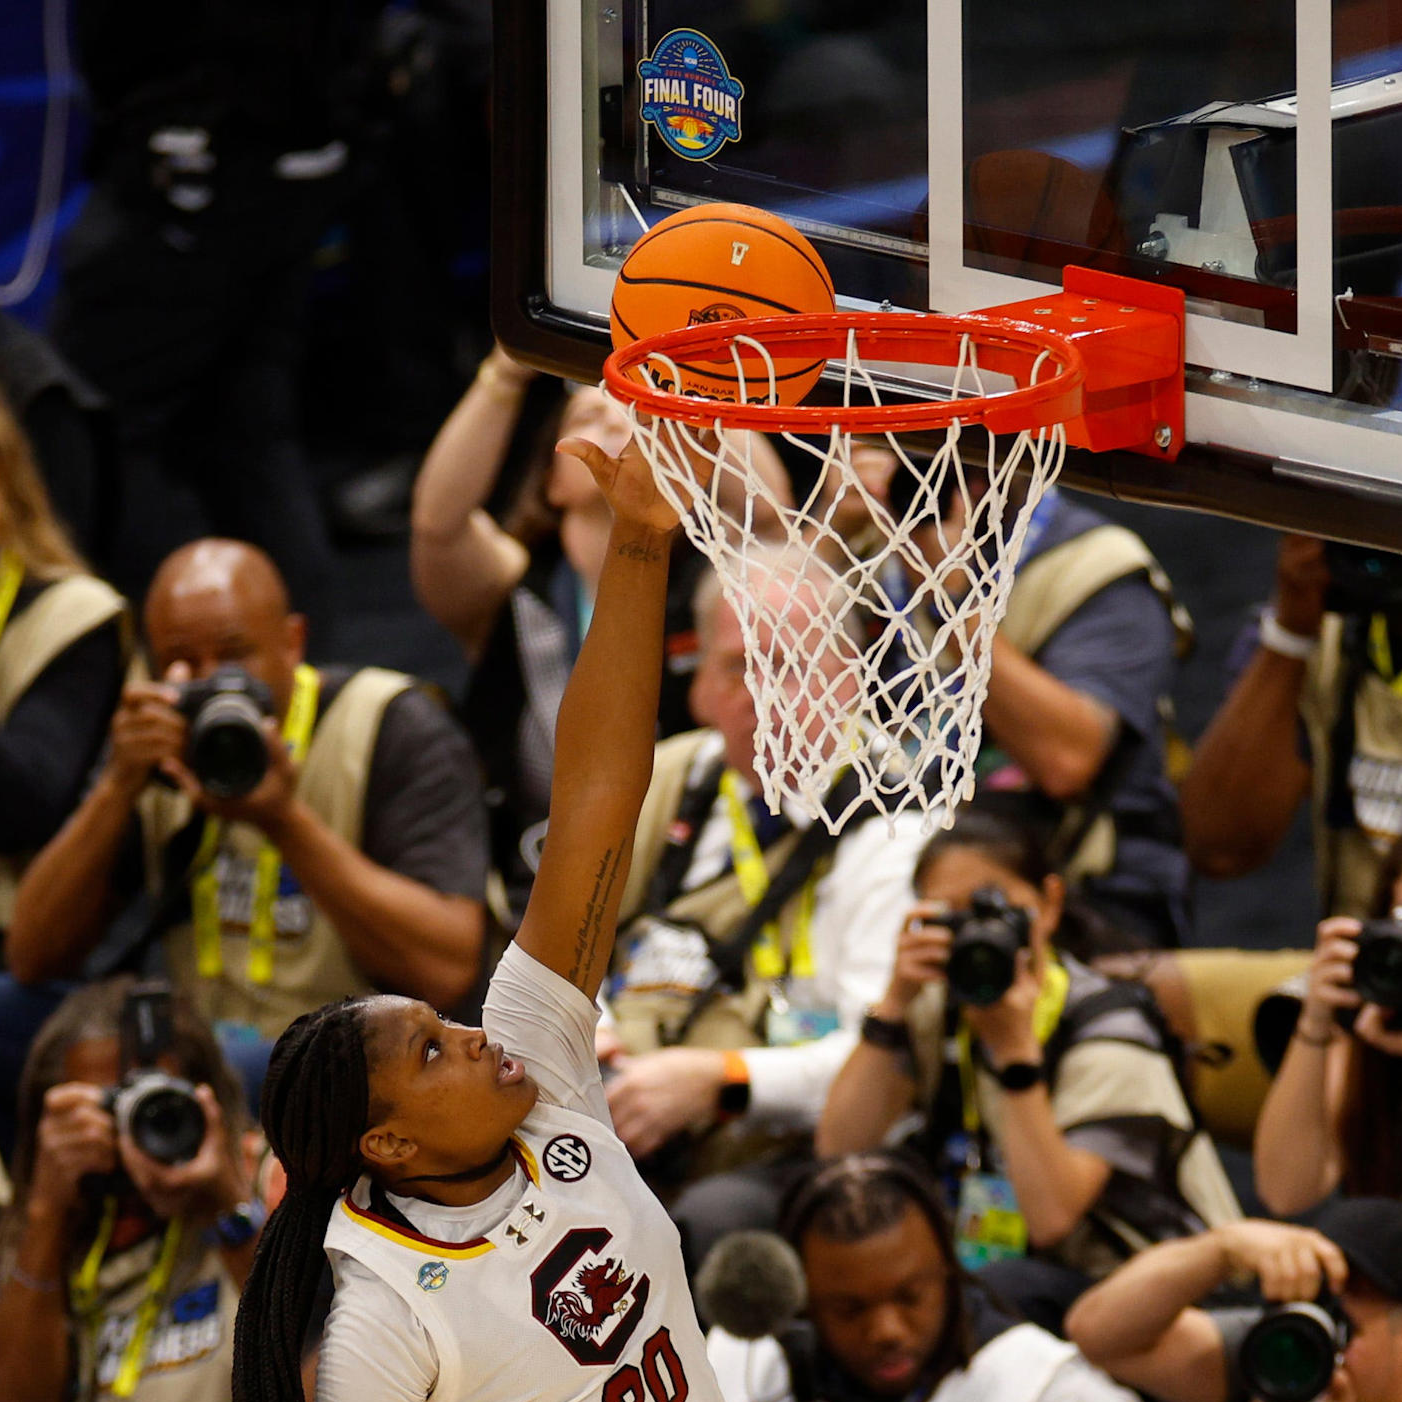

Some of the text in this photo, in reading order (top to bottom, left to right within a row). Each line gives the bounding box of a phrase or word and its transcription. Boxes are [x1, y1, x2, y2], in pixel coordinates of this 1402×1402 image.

[644, 78, 736, 122] FINAL FOUR
[546, 1137, 589, 1180] SEC
